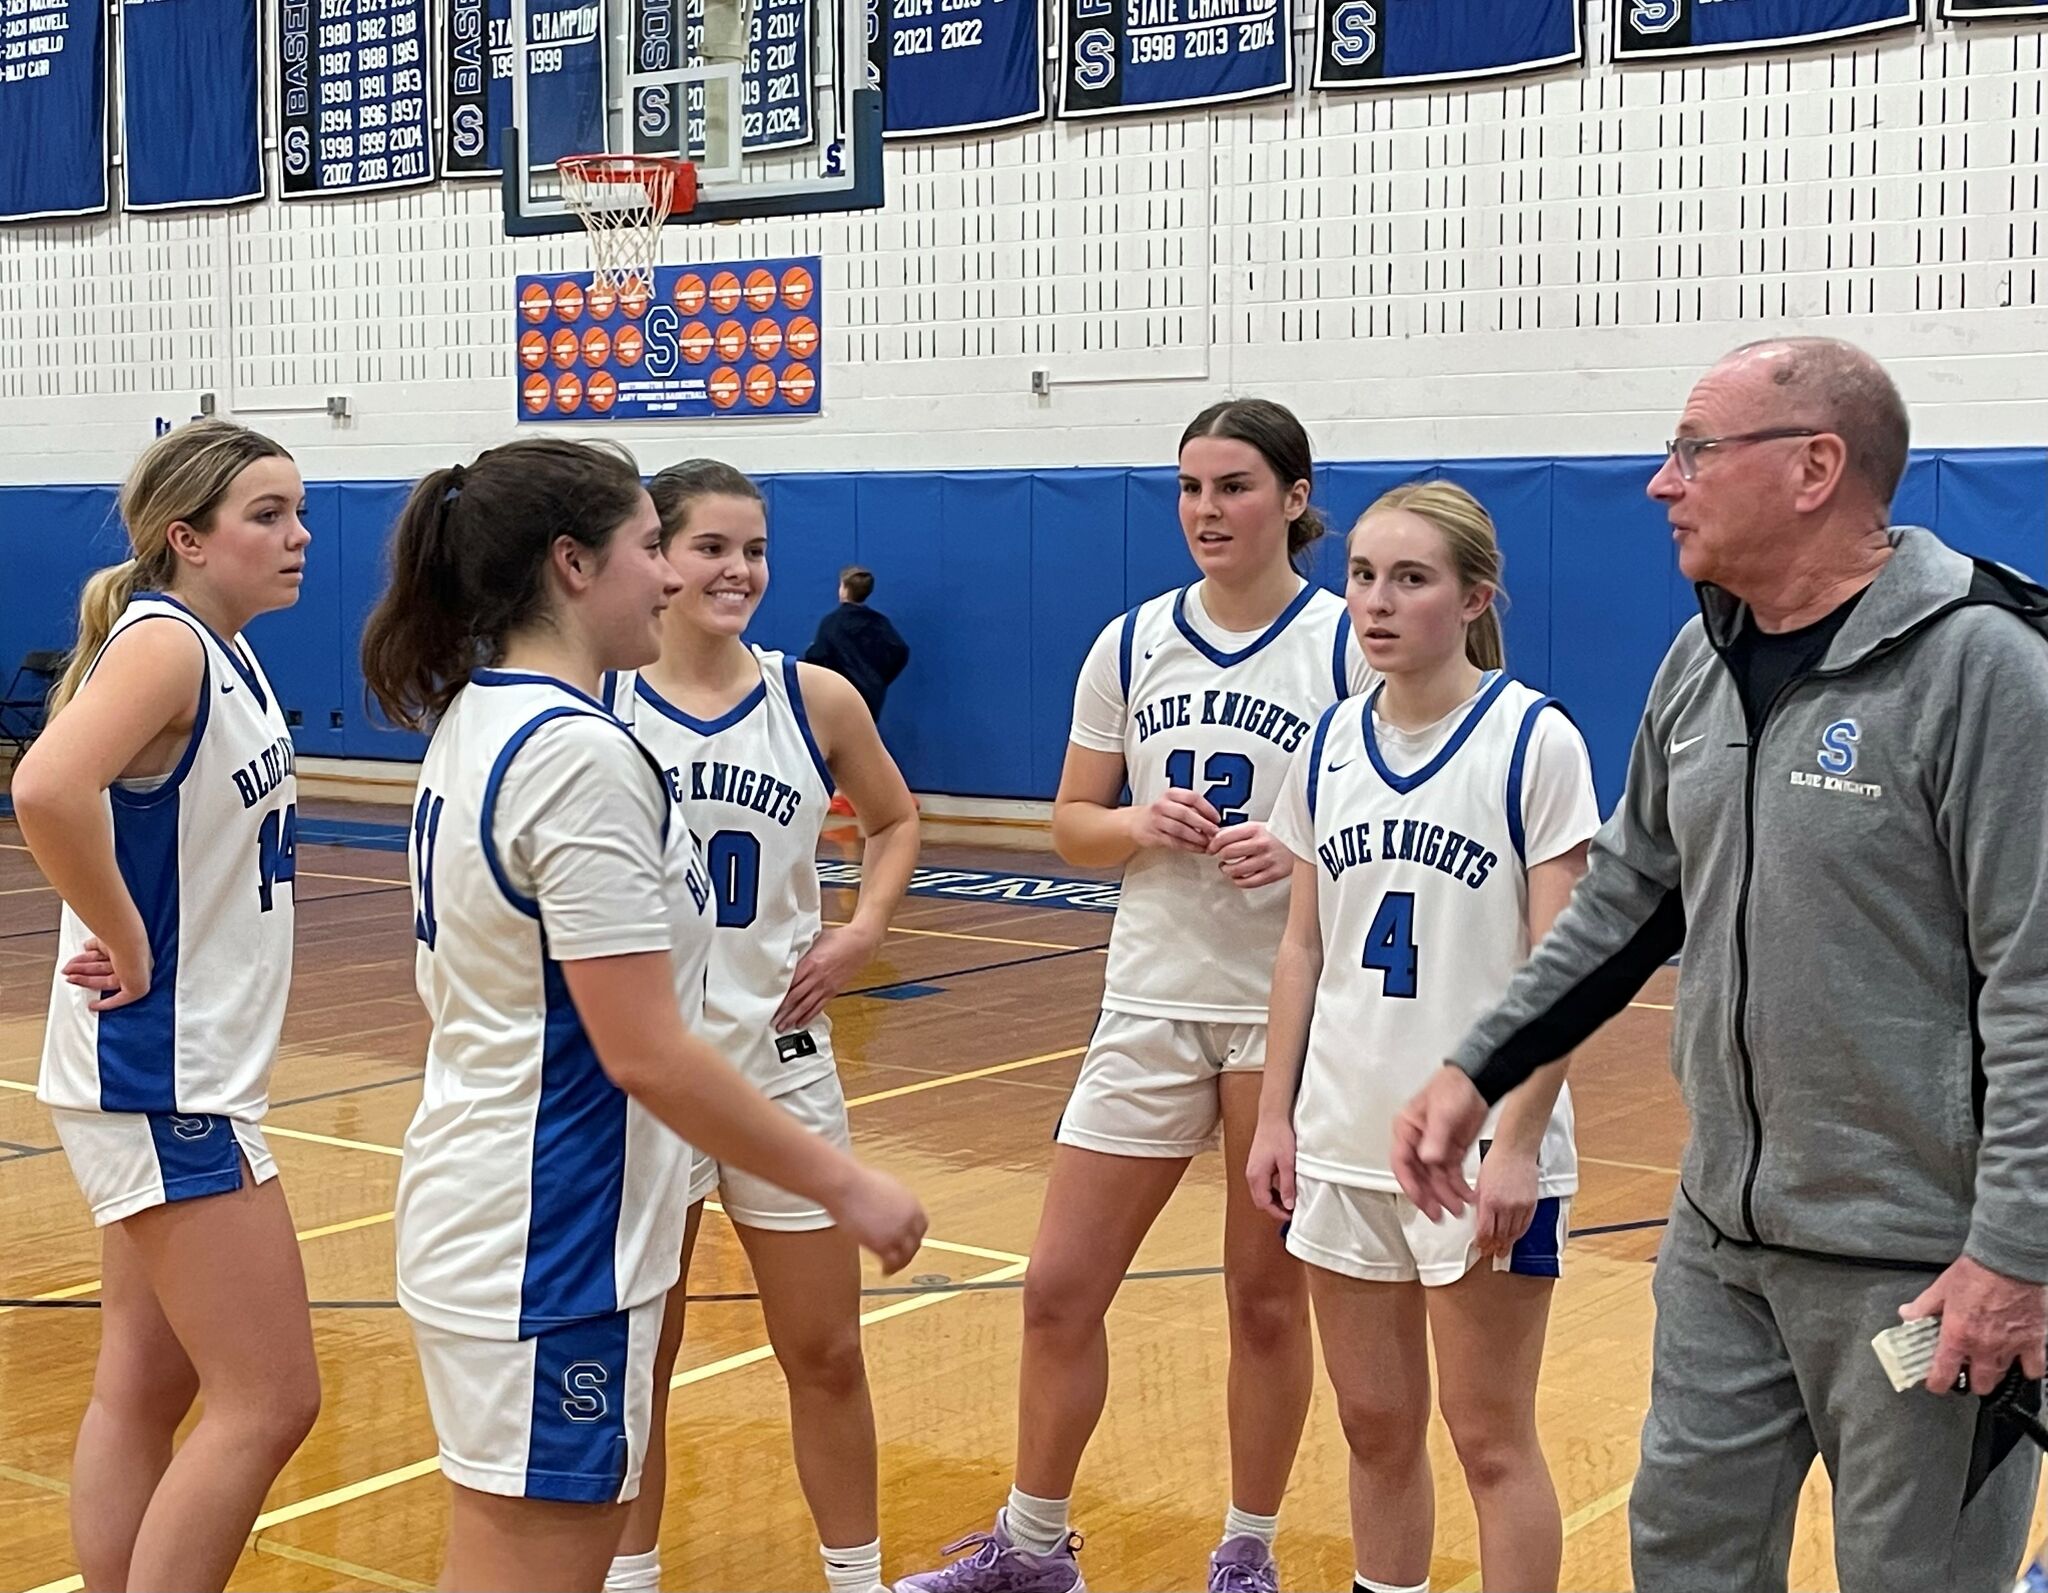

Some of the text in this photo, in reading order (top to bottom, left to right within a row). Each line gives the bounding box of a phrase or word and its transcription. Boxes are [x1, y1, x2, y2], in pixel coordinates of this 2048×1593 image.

[319, 22, 352, 48] 1980
[357, 17, 386, 43] 1982
[893, 19, 982, 56] 2021 2022
[1131, 18, 1274, 64] 1998 2013 2014
[1332, 1, 1376, 66] S
[319, 51, 352, 76] 1987
[358, 46, 387, 71] 1988
[492, 49, 562, 79] 199 1999
[1075, 28, 1115, 90] S
[321, 80, 352, 105] 1990
[359, 75, 386, 100] 1991
[639, 85, 670, 137] S
[320, 98, 423, 133] 1994 1996 1997
[453, 105, 484, 157] S
[767, 106, 800, 135] 2024
[285, 126, 310, 175] S
[320, 125, 423, 160] 1998 1999 2004
[322, 151, 424, 186] 2007 2009 2011
[645, 305, 678, 377] S
[1134, 690, 1310, 753] BLUE KNIGHTS
[1817, 718, 1861, 776] S
[690, 761, 801, 827] KNIGHTS
[1790, 771, 1822, 787] BLUE
[1318, 819, 1498, 889] BLUE KNIGHTS
[1362, 890, 1418, 999] 4
[561, 1362, 608, 1422] S
